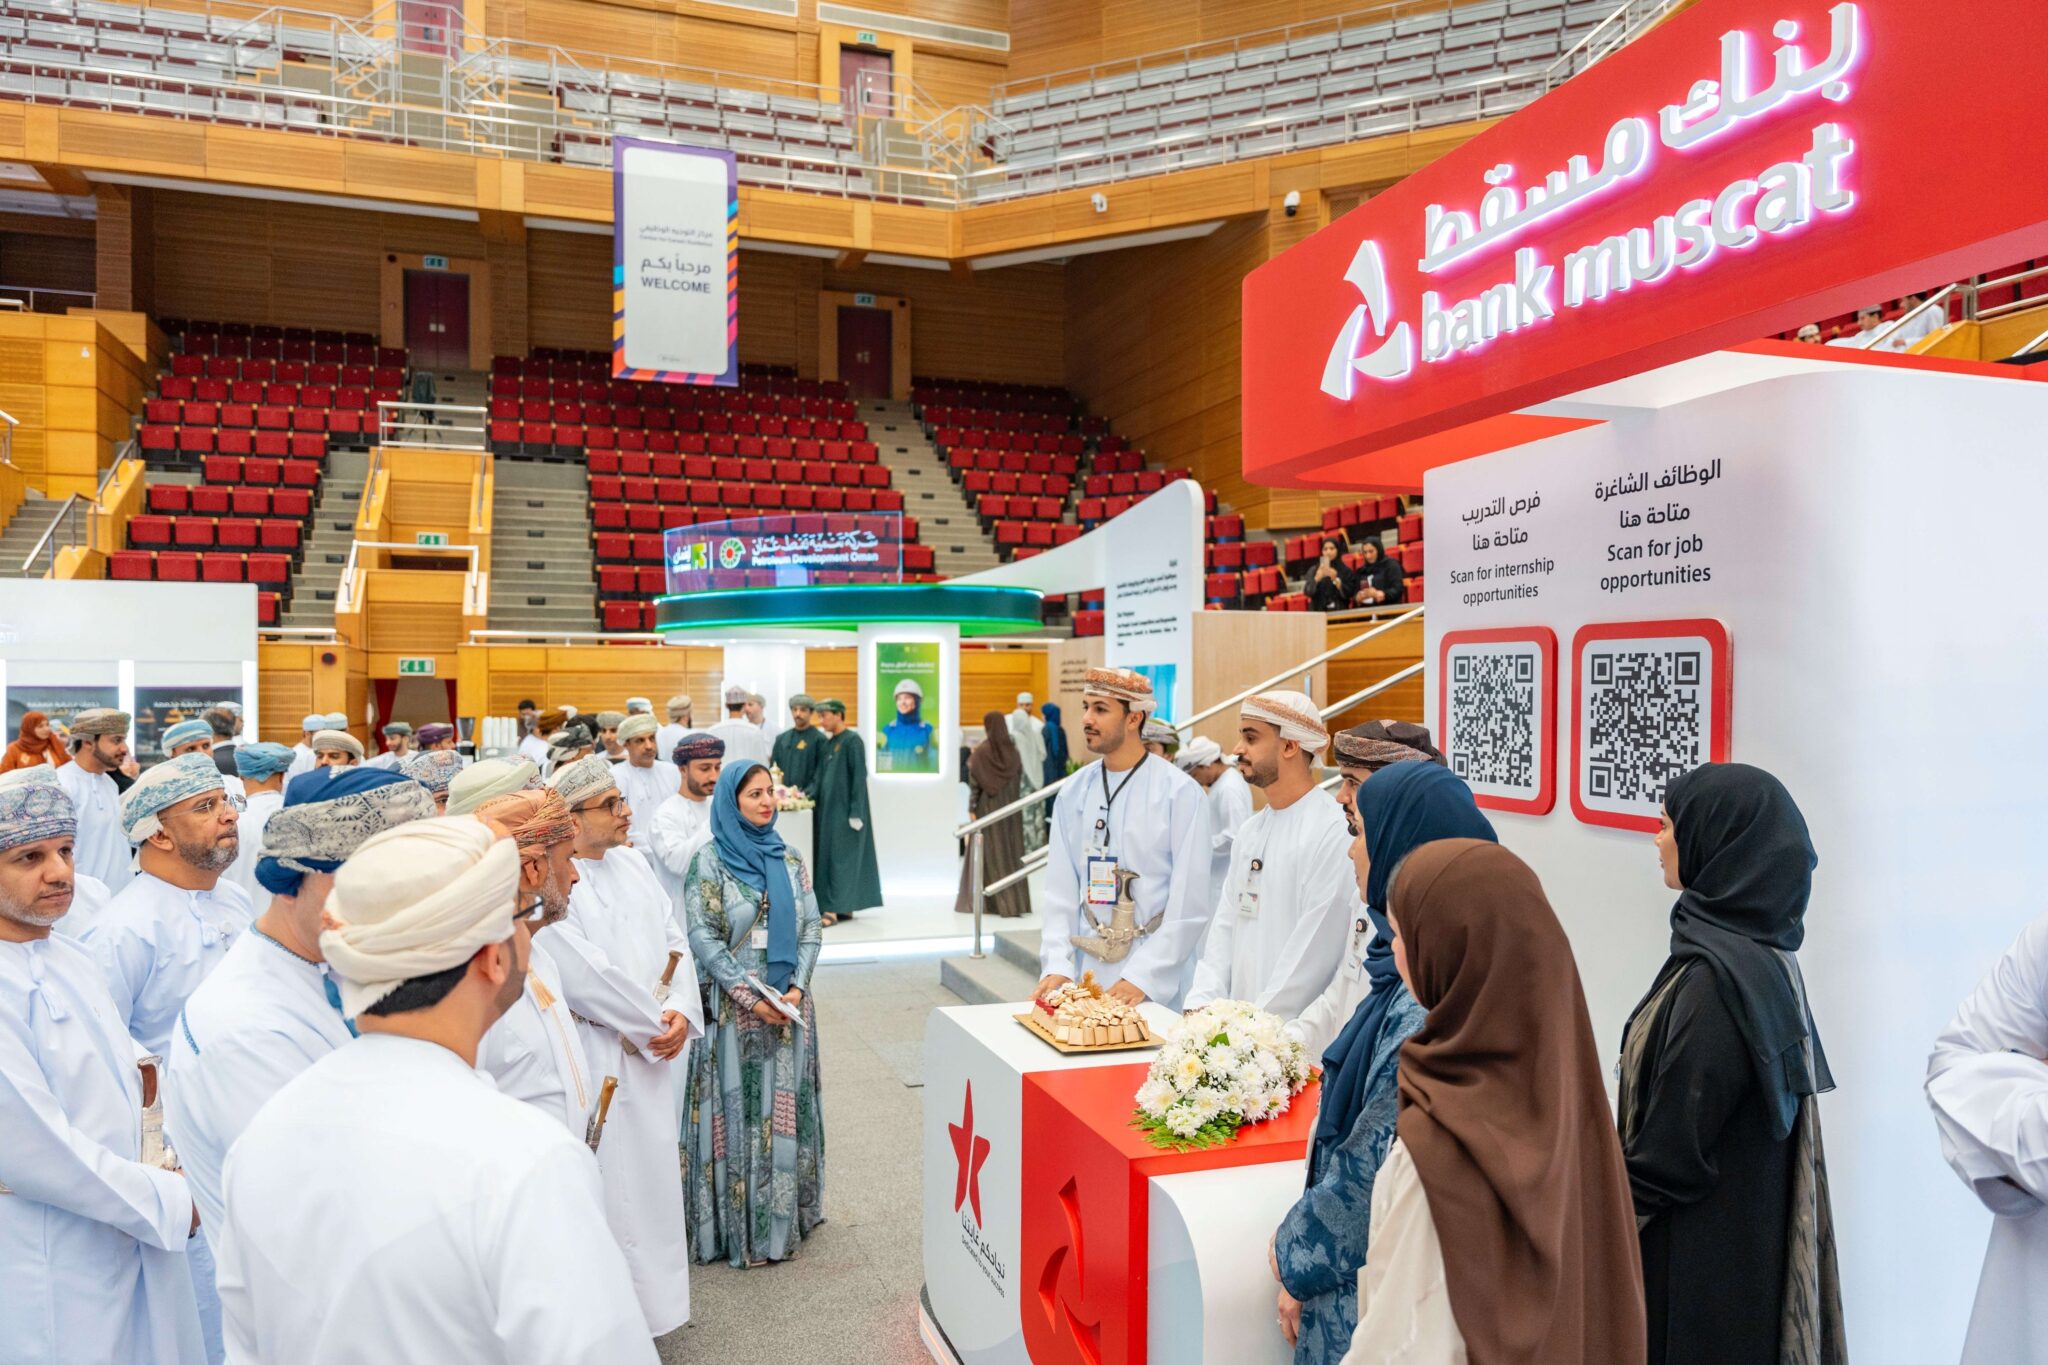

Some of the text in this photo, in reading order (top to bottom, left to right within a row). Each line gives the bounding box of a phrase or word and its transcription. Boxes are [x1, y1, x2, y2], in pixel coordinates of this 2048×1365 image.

[1418, 2, 1858, 273] بنك مسقط
[1422, 122, 1854, 362] bank muscat
[641, 257, 672, 273] بكم
[641, 276, 711, 294] WELCOME
[1595, 458, 1721, 502] الوظائف الشاغرة
[1462, 491, 1541, 526] فرص التدريب
[1619, 502, 1690, 528] متاحة هنا
[1472, 527, 1529, 551] متاحة هنا
[1607, 533, 1703, 562] Scan for job
[752, 552, 879, 566] Petroleum Development Oman
[1450, 557, 1555, 584] Scan for internship
[1600, 564, 1711, 593] opportunities
[1463, 583, 1539, 607] opportunities
[962, 1210, 1005, 1279] نجاحكم غايتنا
